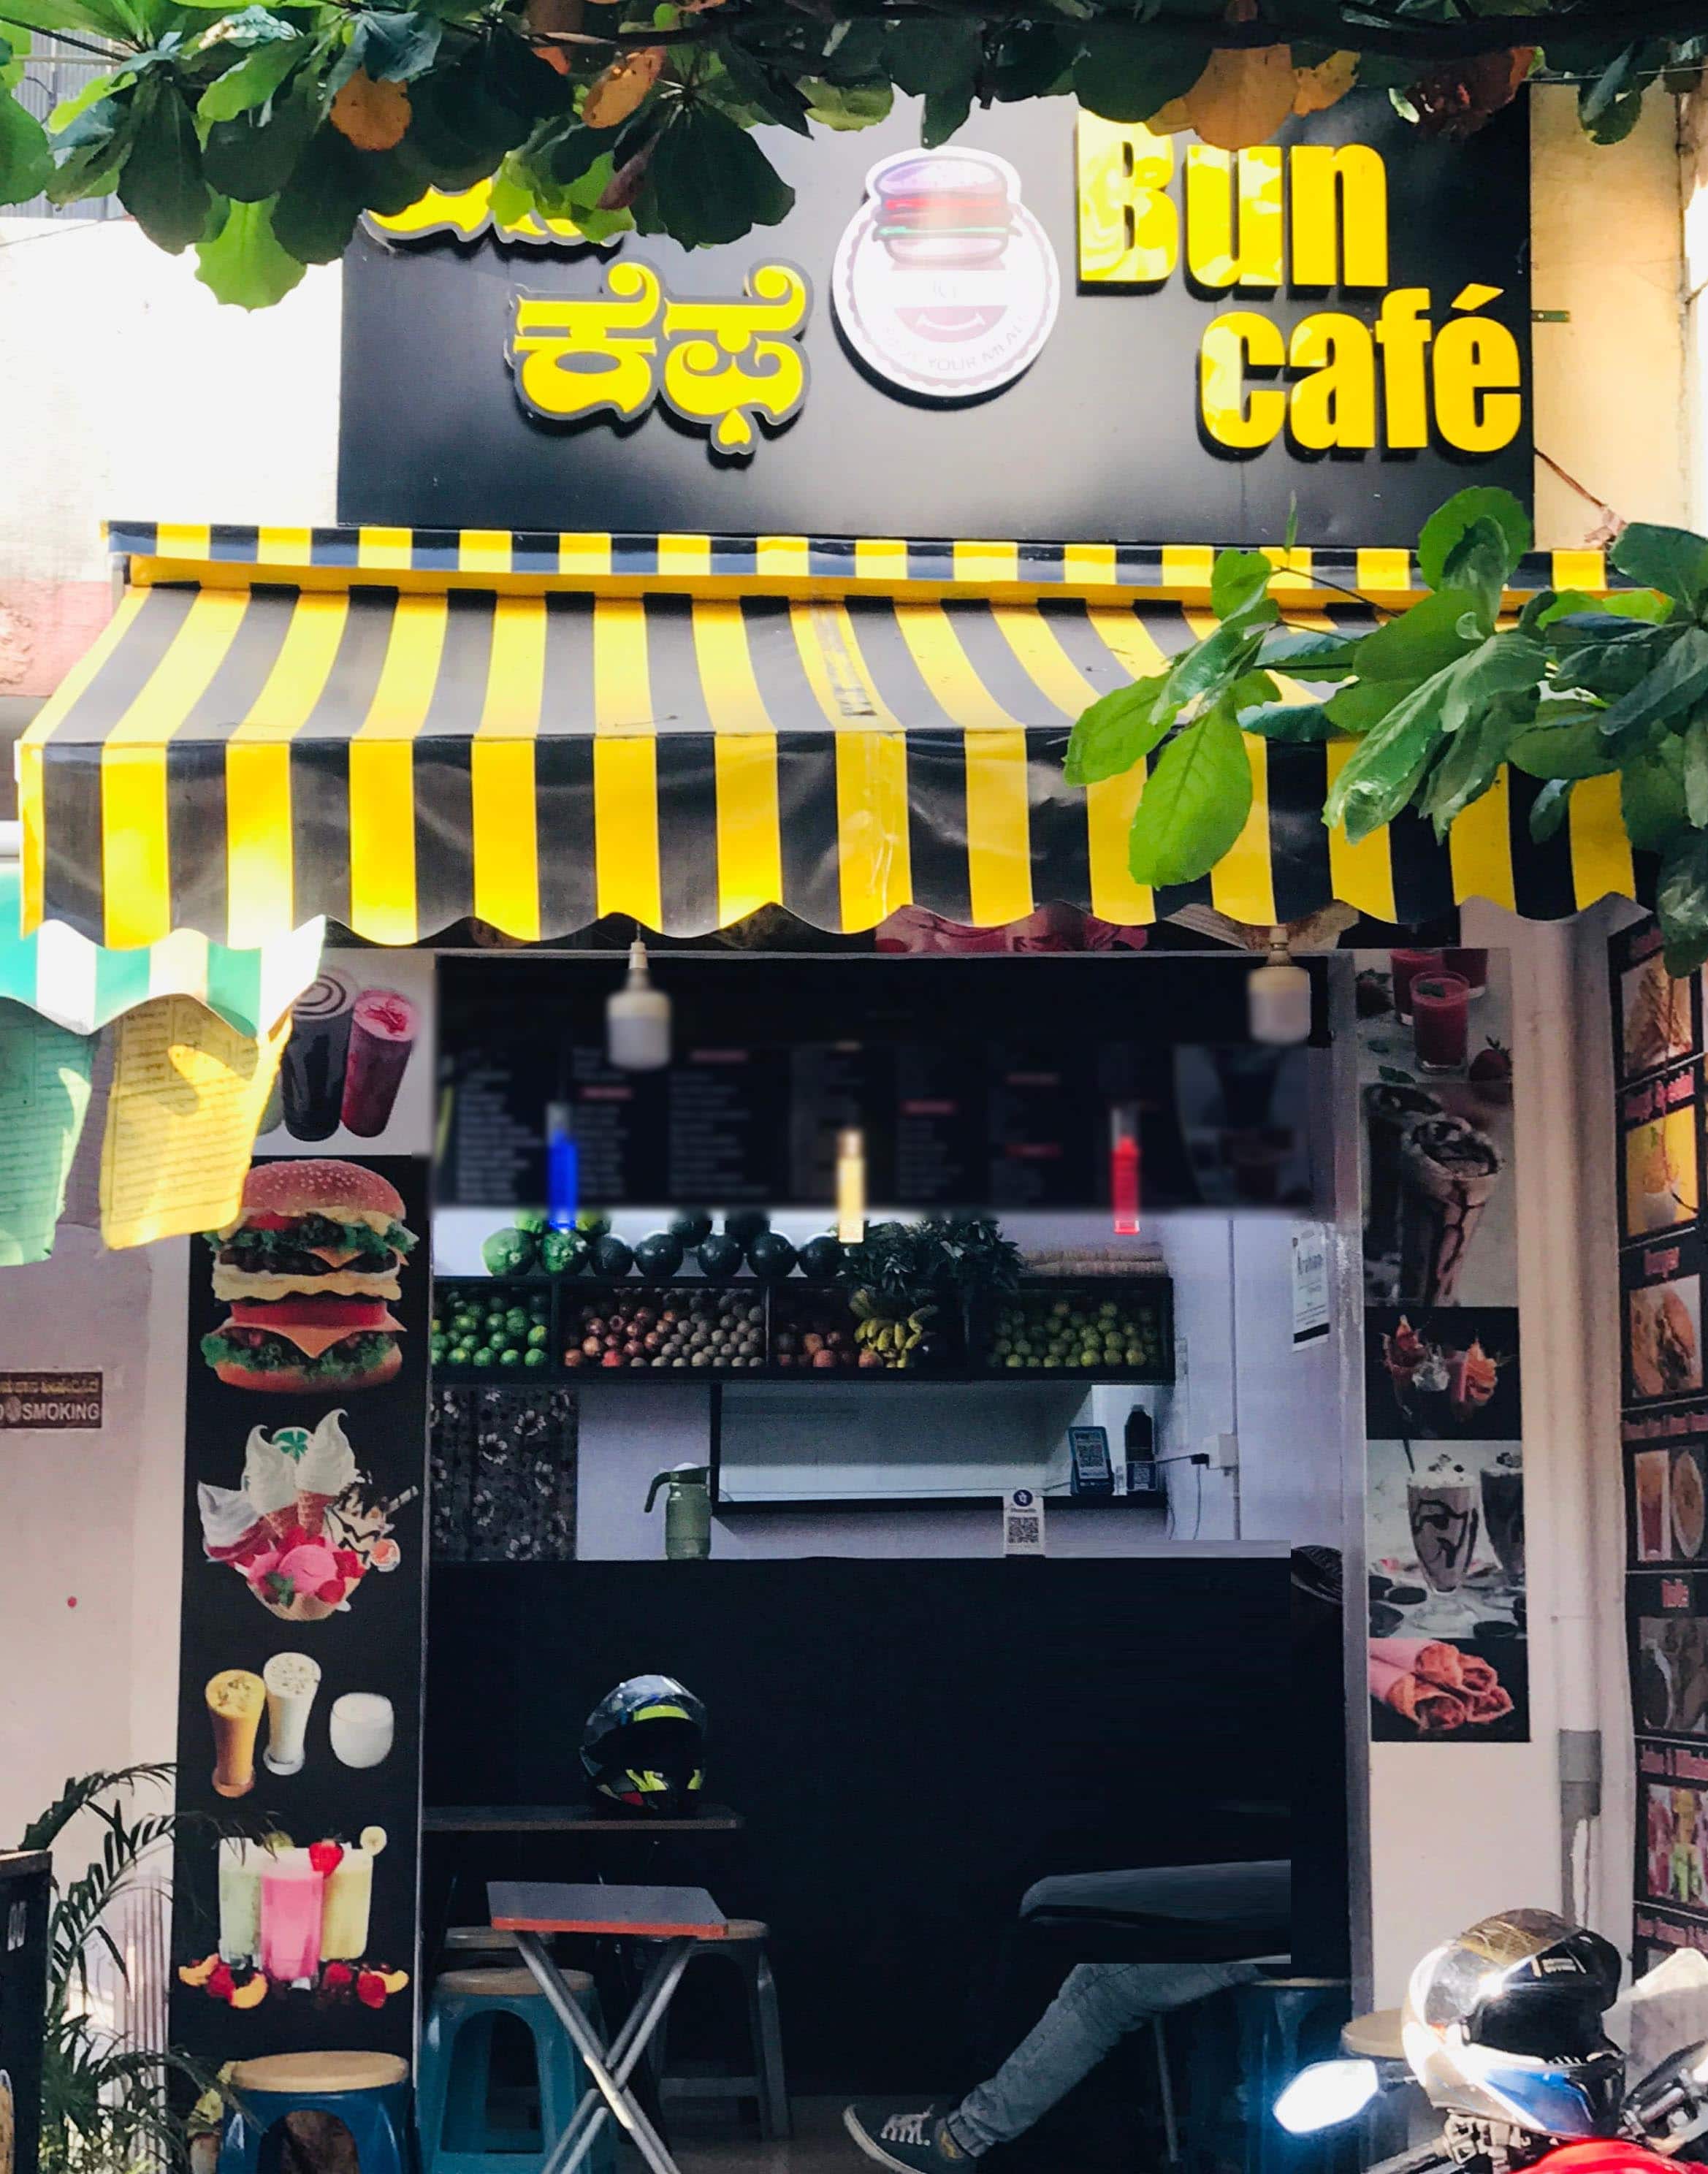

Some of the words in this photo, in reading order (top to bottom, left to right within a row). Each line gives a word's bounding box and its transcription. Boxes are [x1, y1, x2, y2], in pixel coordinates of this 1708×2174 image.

[1077, 108, 1388, 288] Bun
[1200, 283, 1521, 453] café
[22, 1402, 100, 1421] SMOKING
